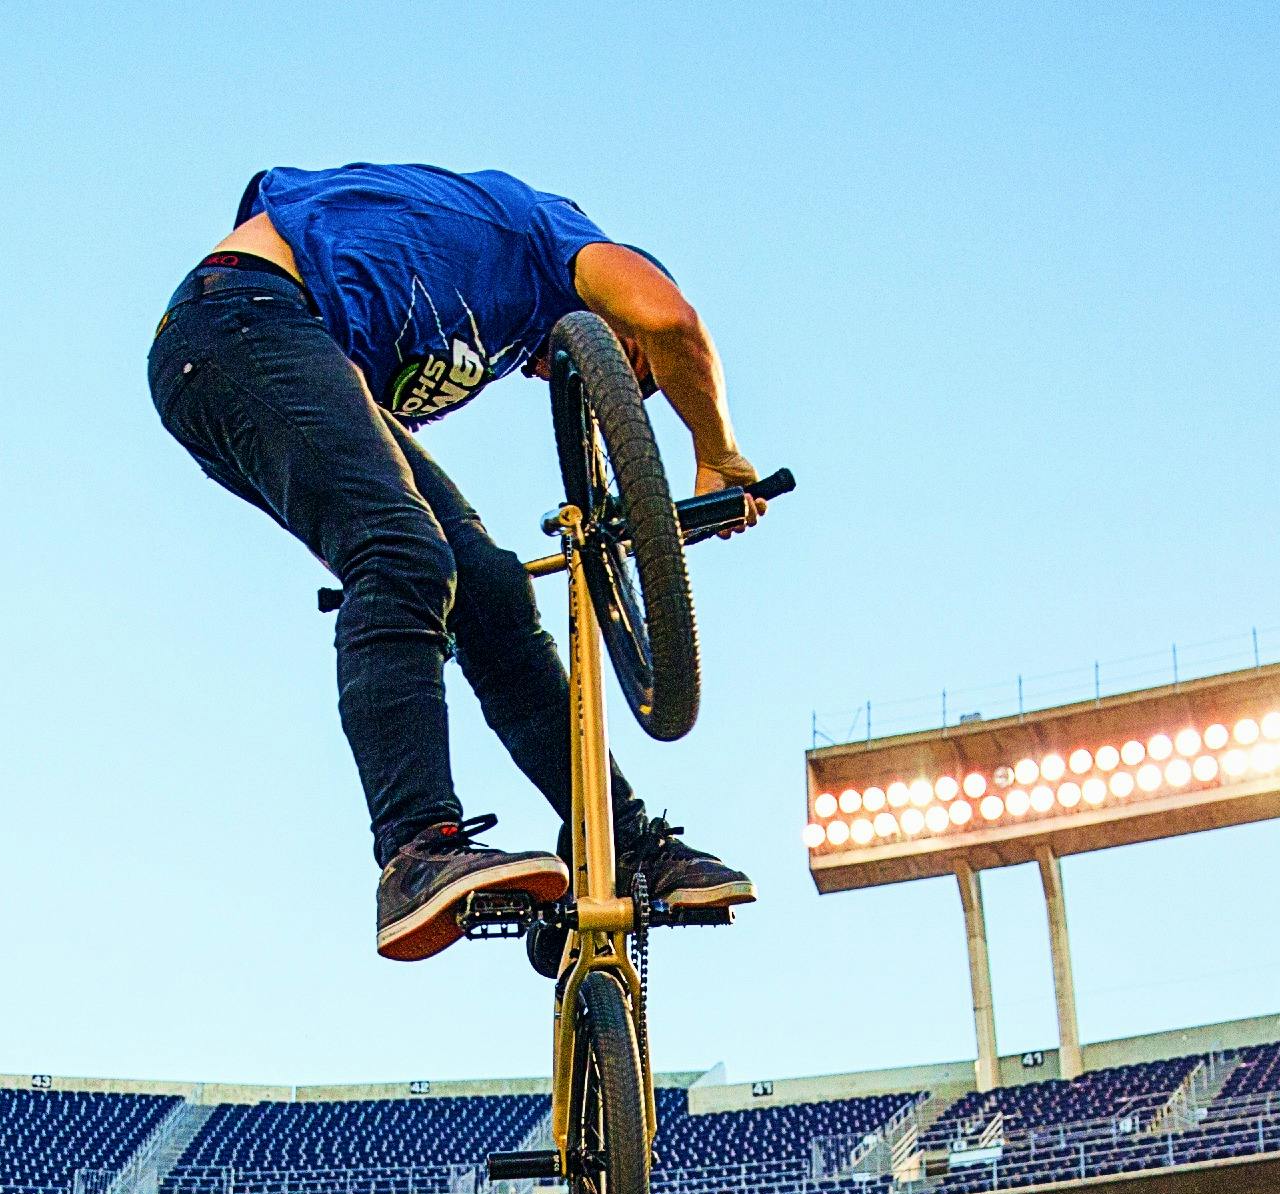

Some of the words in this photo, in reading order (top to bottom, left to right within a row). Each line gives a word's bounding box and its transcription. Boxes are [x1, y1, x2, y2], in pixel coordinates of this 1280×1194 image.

[1022, 1052, 1043, 1066] 41
[32, 1075, 51, 1088] 43
[753, 1082, 772, 1095] 41
